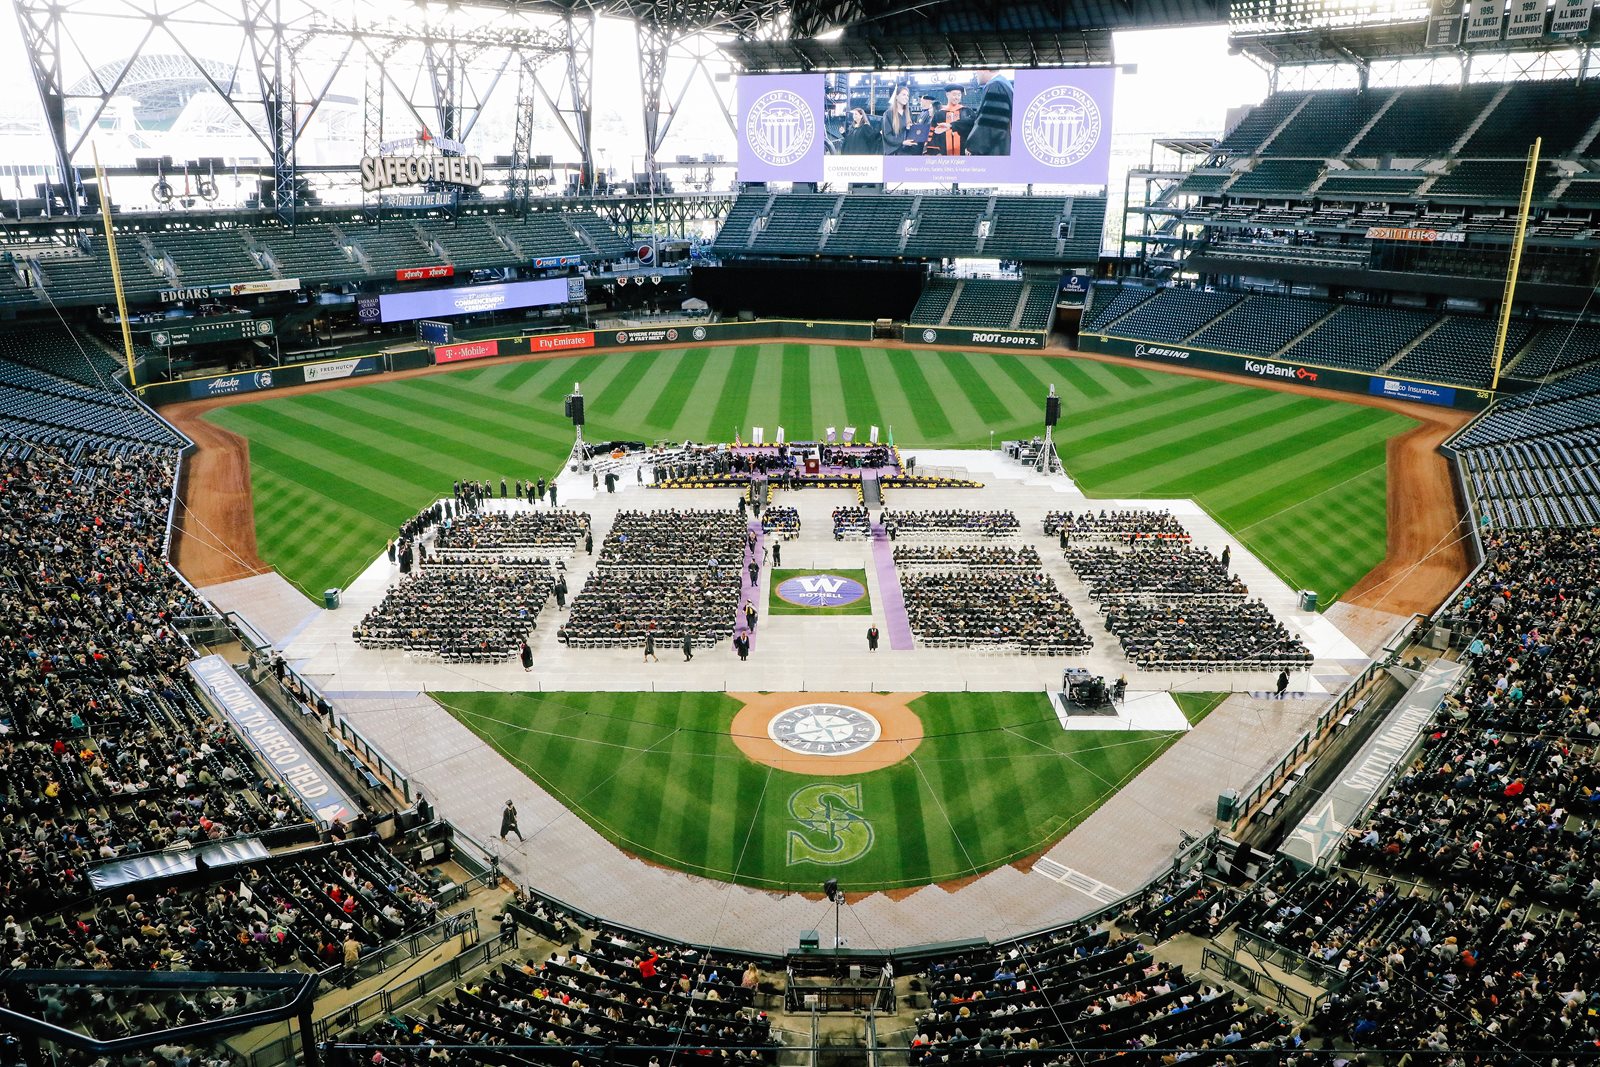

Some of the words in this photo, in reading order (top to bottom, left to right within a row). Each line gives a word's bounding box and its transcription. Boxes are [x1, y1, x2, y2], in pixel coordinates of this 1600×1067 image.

[1480, 6, 1494, 15] 1995
[1522, 2, 1536, 11] 1997
[1525, 13, 1542, 22] WEST
[1570, 8, 1588, 18] WEST
[1483, 17, 1498, 26] WEST
[1553, 20, 1588, 31] CHAMPIONS
[1468, 29, 1500, 39] CHAMPIONS
[1508, 25, 1542, 36] CHAMPIONS
[1050, 157, 1071, 165] 1861
[360, 156, 430, 192] SAFECO
[432, 156, 484, 188] FIELD
[396, 194, 412, 206] TRUE
[413, 195, 422, 205] TO
[423, 194, 434, 205] THE
[435, 192, 451, 205] BLUE
[405, 271, 423, 279] xfinity
[429, 269, 447, 277] xfinity
[160, 288, 209, 302] EDGARS
[455, 296, 505, 306] COMMENCEMENT
[464, 303, 496, 312] CEREMONY
[540, 340, 552, 348] Fly
[554, 337, 586, 346] Emirates
[972, 333, 1001, 342] ROOT
[1000, 336, 1036, 344] SPORTS
[1147, 348, 1190, 359] BOEING
[1245, 360, 1296, 378] KeyBank
[208, 377, 240, 389] Alaska
[1408, 386, 1437, 395] Insurance
[796, 578, 847, 592] W
[206, 670, 256, 714] WELCOME
[241, 710, 269, 728] TO
[778, 708, 858, 729] SEATTLE
[252, 726, 300, 765] SAFECO
[1343, 748, 1398, 793] SEATTLE
[1375, 705, 1432, 750] MARINERS
[286, 763, 329, 798] FIELD
